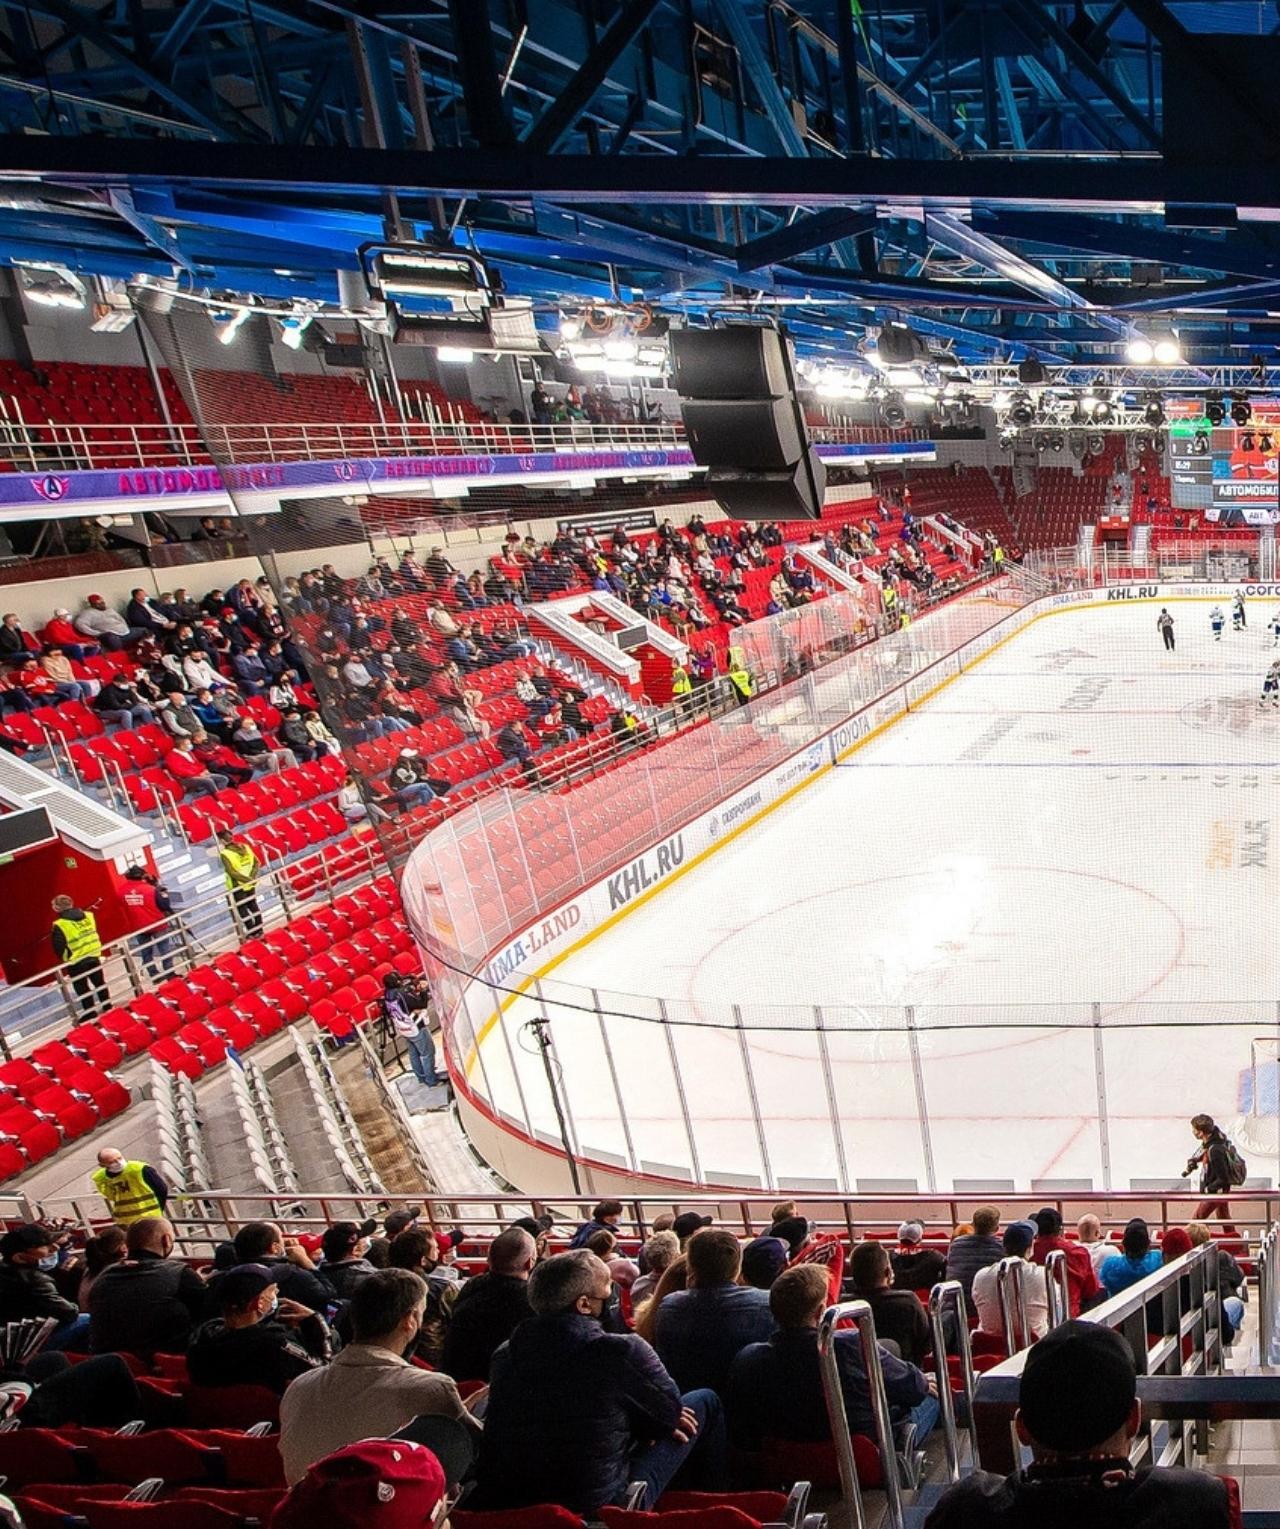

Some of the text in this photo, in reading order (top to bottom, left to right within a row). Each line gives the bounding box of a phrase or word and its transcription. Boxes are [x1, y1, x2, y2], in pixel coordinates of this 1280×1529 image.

[1218, 485, 1279, 496] АВТОМОБИЛ
[1107, 586, 1158, 601] KHL.RU
[833, 715, 870, 752] TOYOTA
[607, 833, 684, 911] KHL.RU
